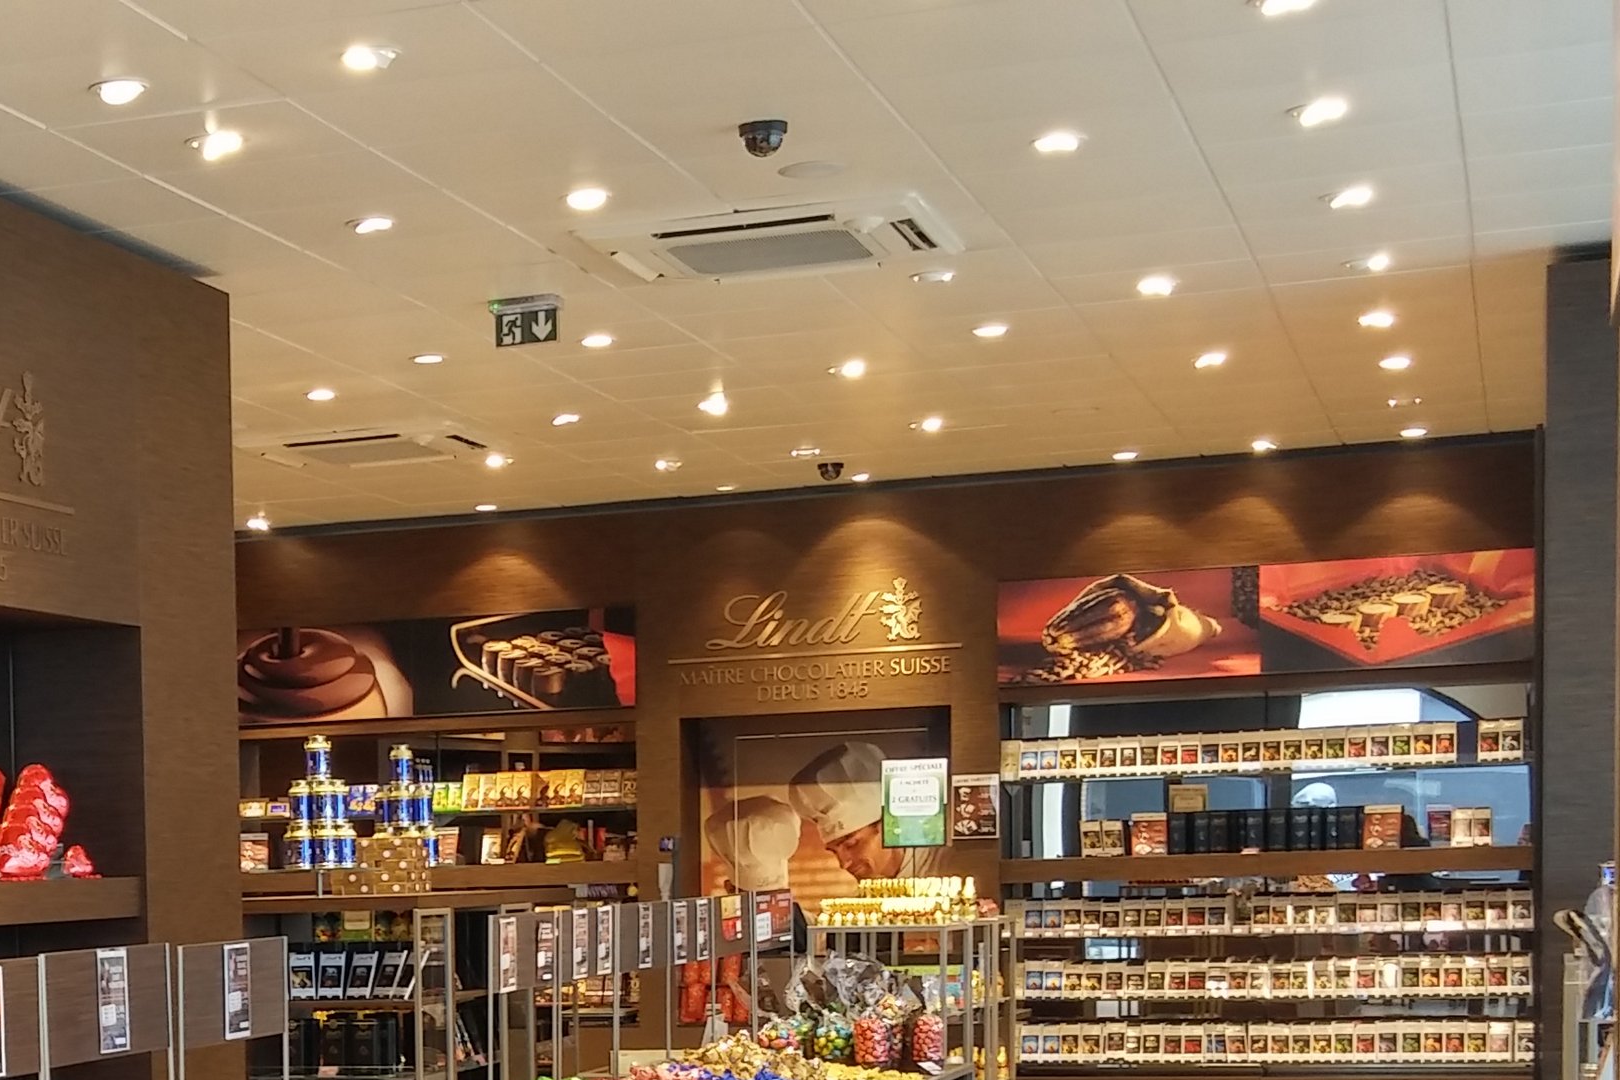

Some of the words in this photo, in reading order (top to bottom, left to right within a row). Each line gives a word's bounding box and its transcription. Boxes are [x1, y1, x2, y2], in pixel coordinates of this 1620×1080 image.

[23, 520, 68, 557] SUISSE
[706, 590, 881, 650] Lindt
[680, 664, 744, 686] MAÎTRE
[750, 659, 886, 684] CHOCOLATIER
[890, 656, 952, 677] SUISSE
[757, 681, 821, 703] DEPUIS
[828, 681, 869, 700] 1845
